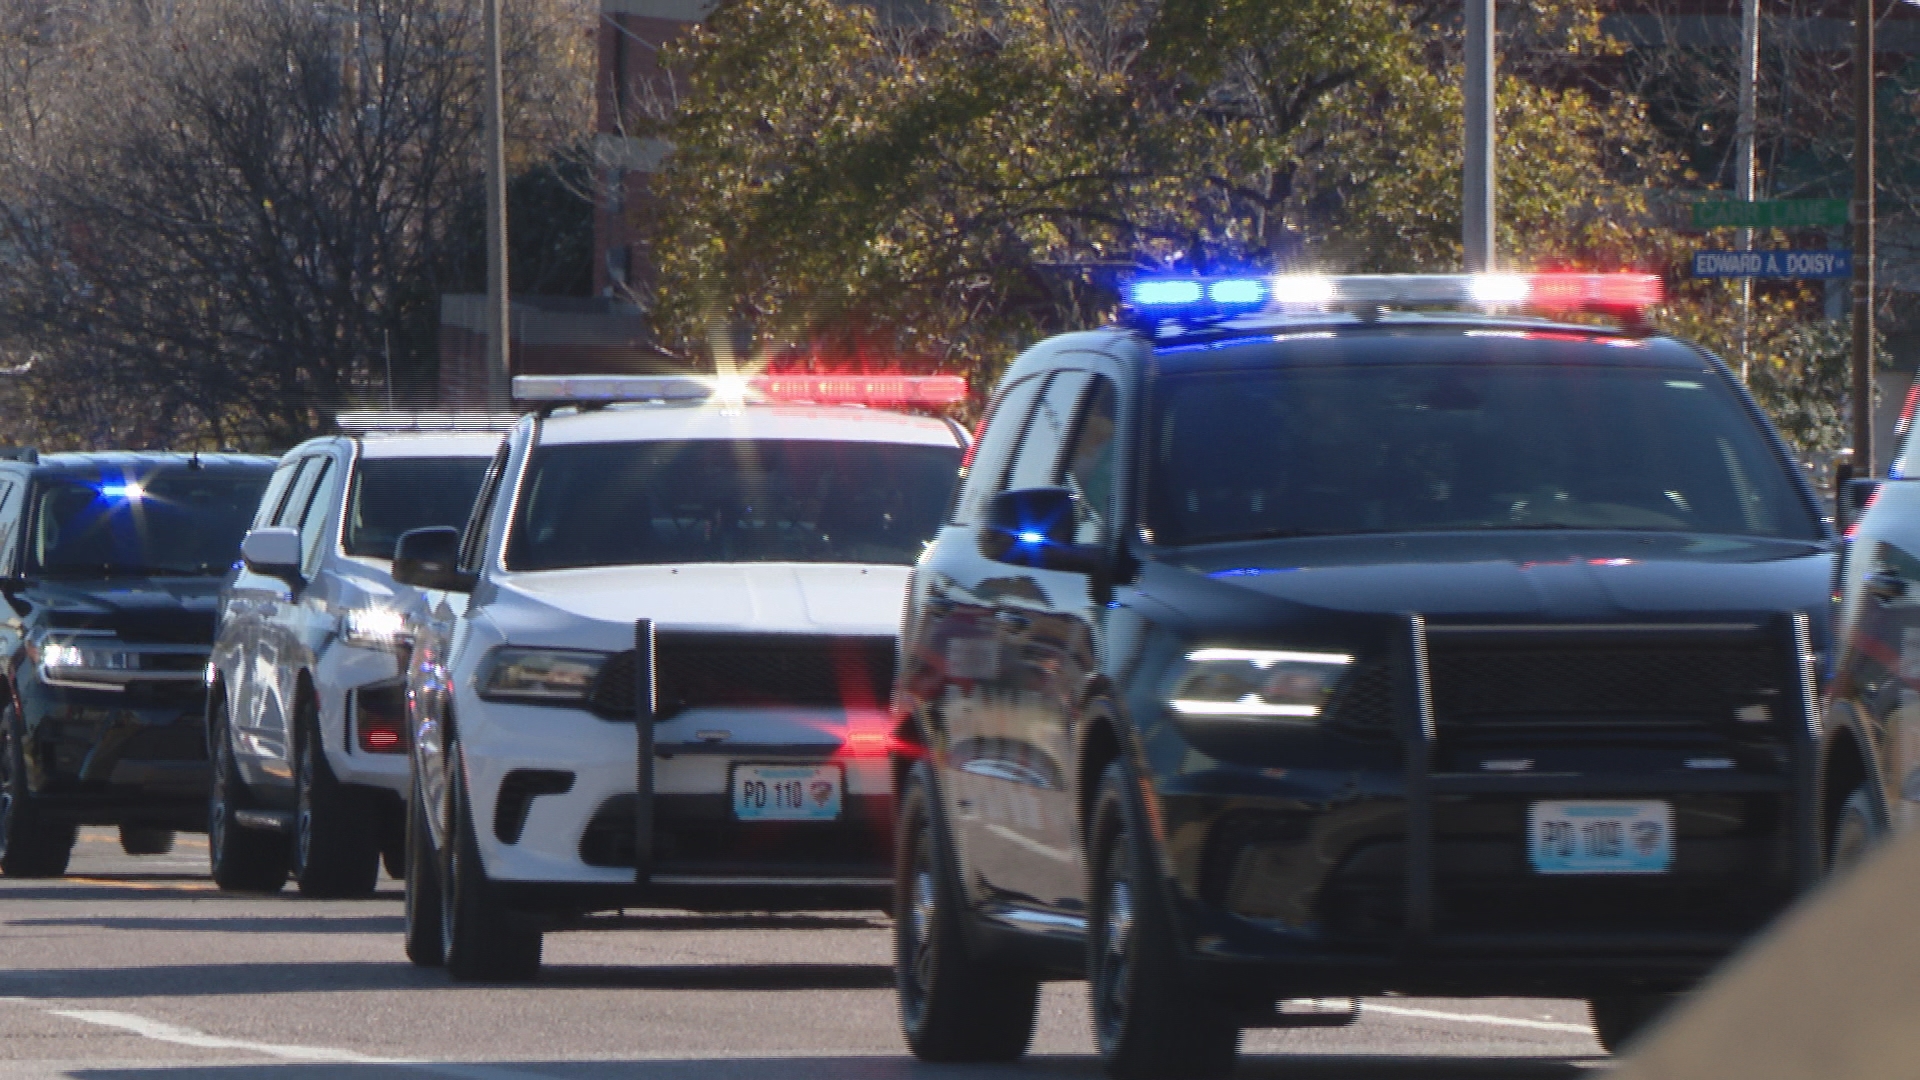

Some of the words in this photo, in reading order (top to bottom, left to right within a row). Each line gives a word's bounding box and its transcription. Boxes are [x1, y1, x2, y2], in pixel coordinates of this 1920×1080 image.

[1770, 203, 1829, 221] LANE
[1697, 254, 1762, 274] EDWARD
[1787, 253, 1835, 273] DOISY
[744, 781, 766, 808] PD
[772, 781, 803, 808] 110
[1541, 821, 1576, 858] PD
[1580, 821, 1624, 858] 109
